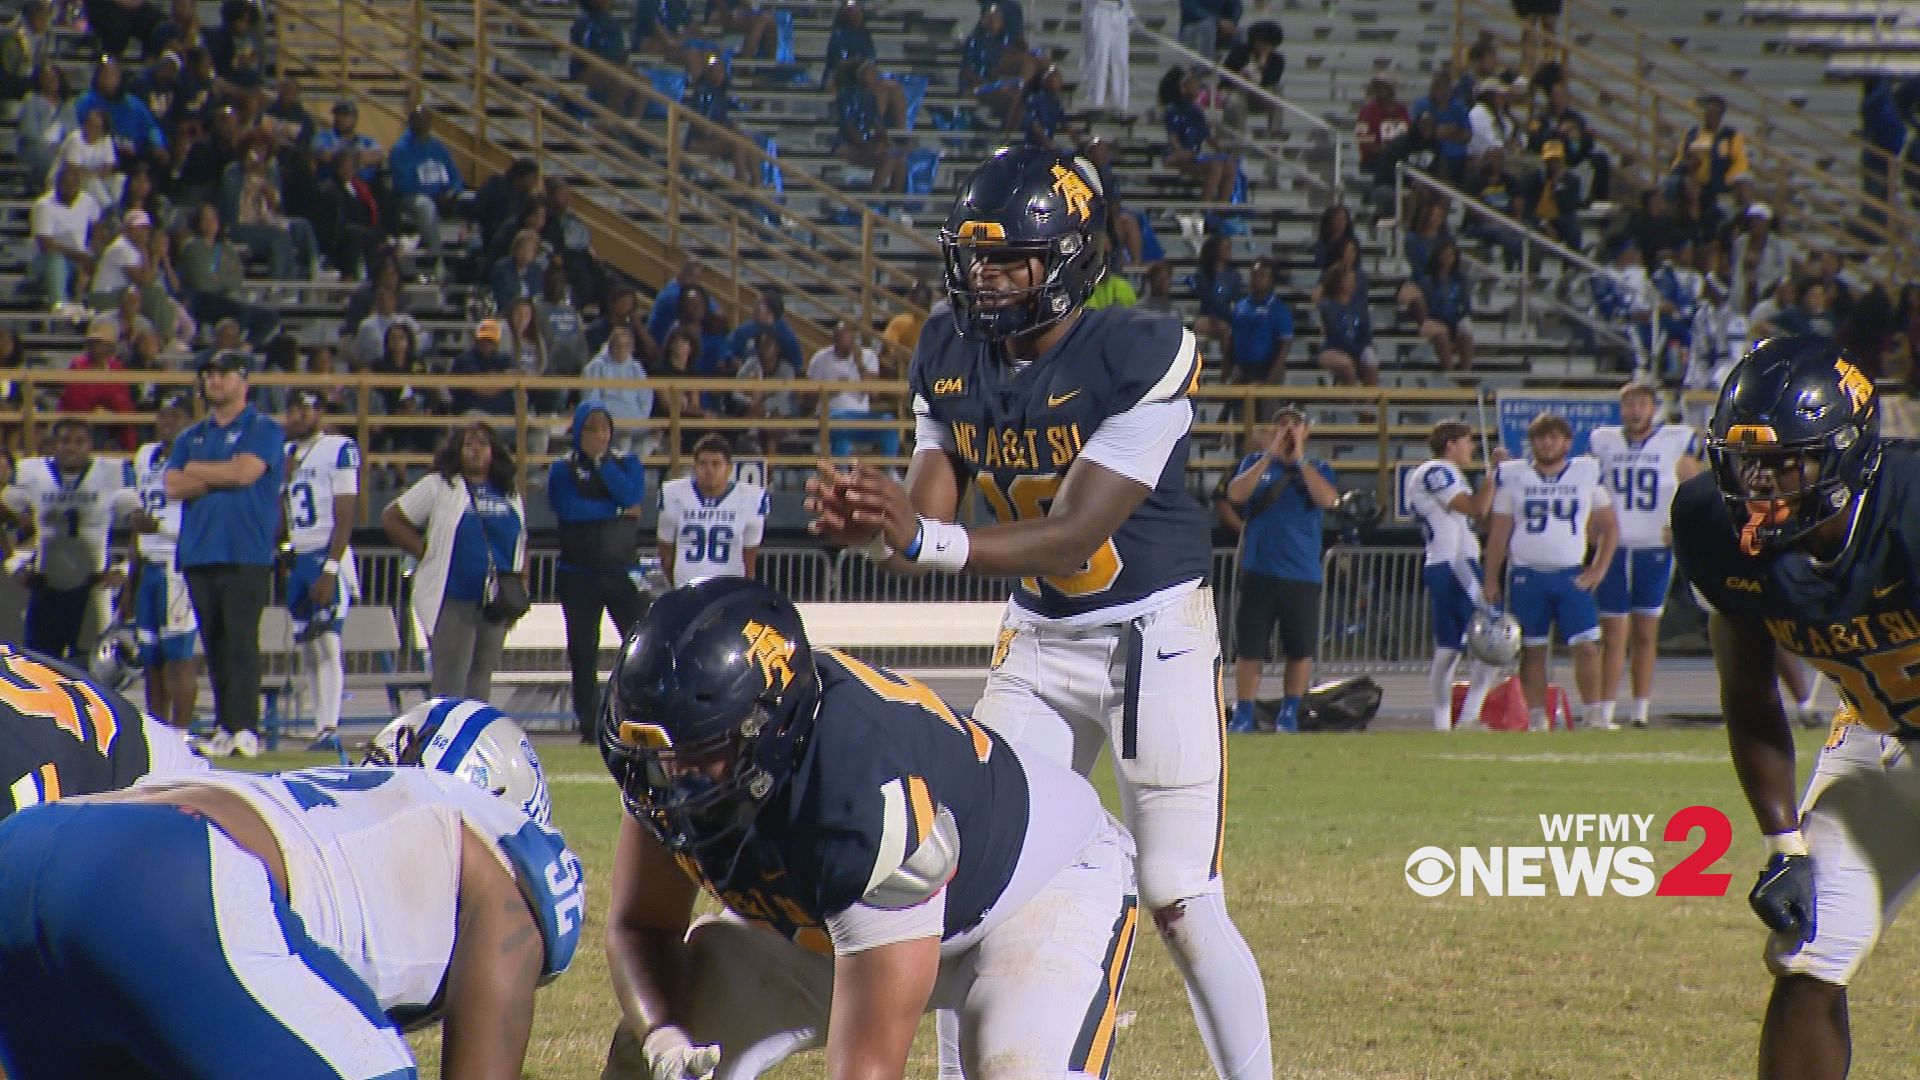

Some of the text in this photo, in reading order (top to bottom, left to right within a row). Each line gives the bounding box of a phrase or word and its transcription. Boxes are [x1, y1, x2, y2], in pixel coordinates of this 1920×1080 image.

[934, 376, 963, 395] CAA
[952, 420, 1082, 469] NC A&T SU
[1612, 466, 1659, 511] 49
[681, 524, 735, 564] 36
[1726, 576, 1763, 593] CAA
[1806, 614, 1879, 656] A&T
